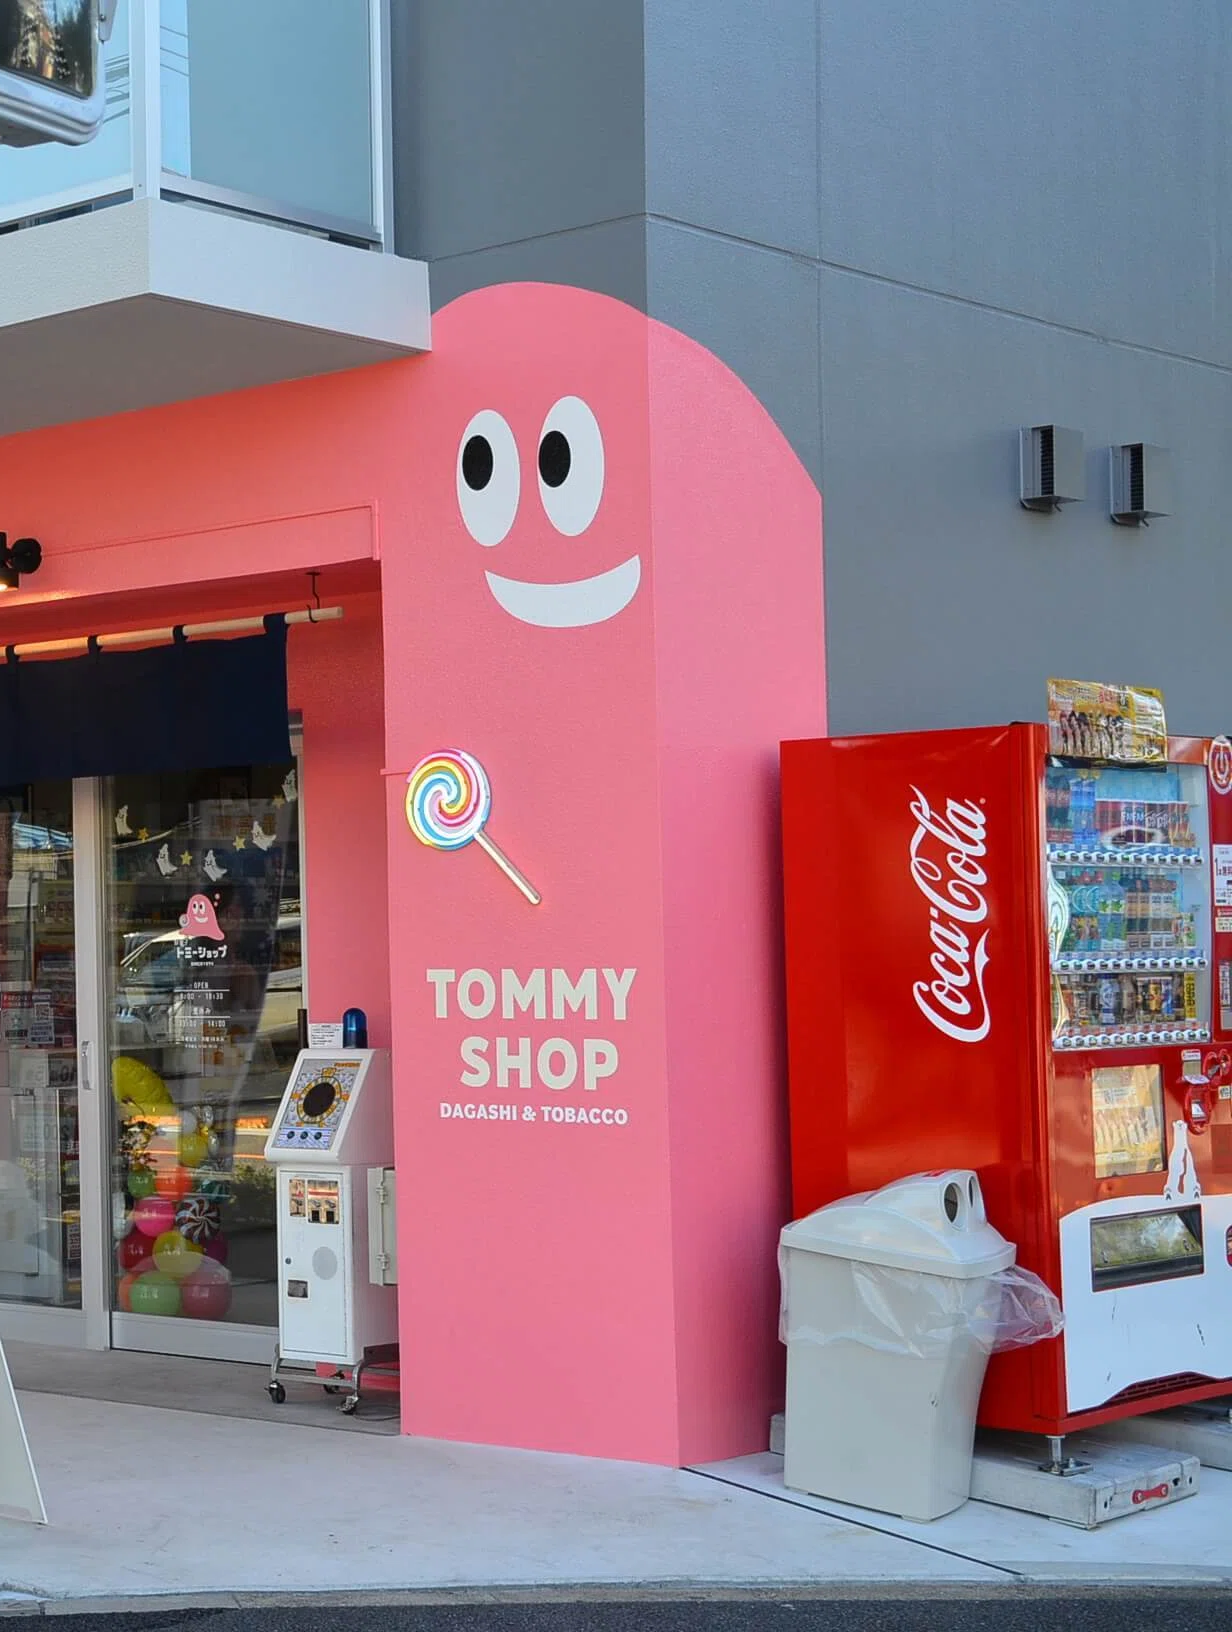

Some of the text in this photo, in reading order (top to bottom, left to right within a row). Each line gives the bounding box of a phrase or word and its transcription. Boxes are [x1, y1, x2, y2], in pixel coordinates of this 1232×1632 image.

[909, 784, 991, 1042] Coca-Cola
[176, 945, 227, 958] トミーショップ
[426, 968, 637, 1020] TOMMY
[460, 1036, 619, 1091] SHOP
[440, 1102, 628, 1125] DAGASHI & TOBACCO
